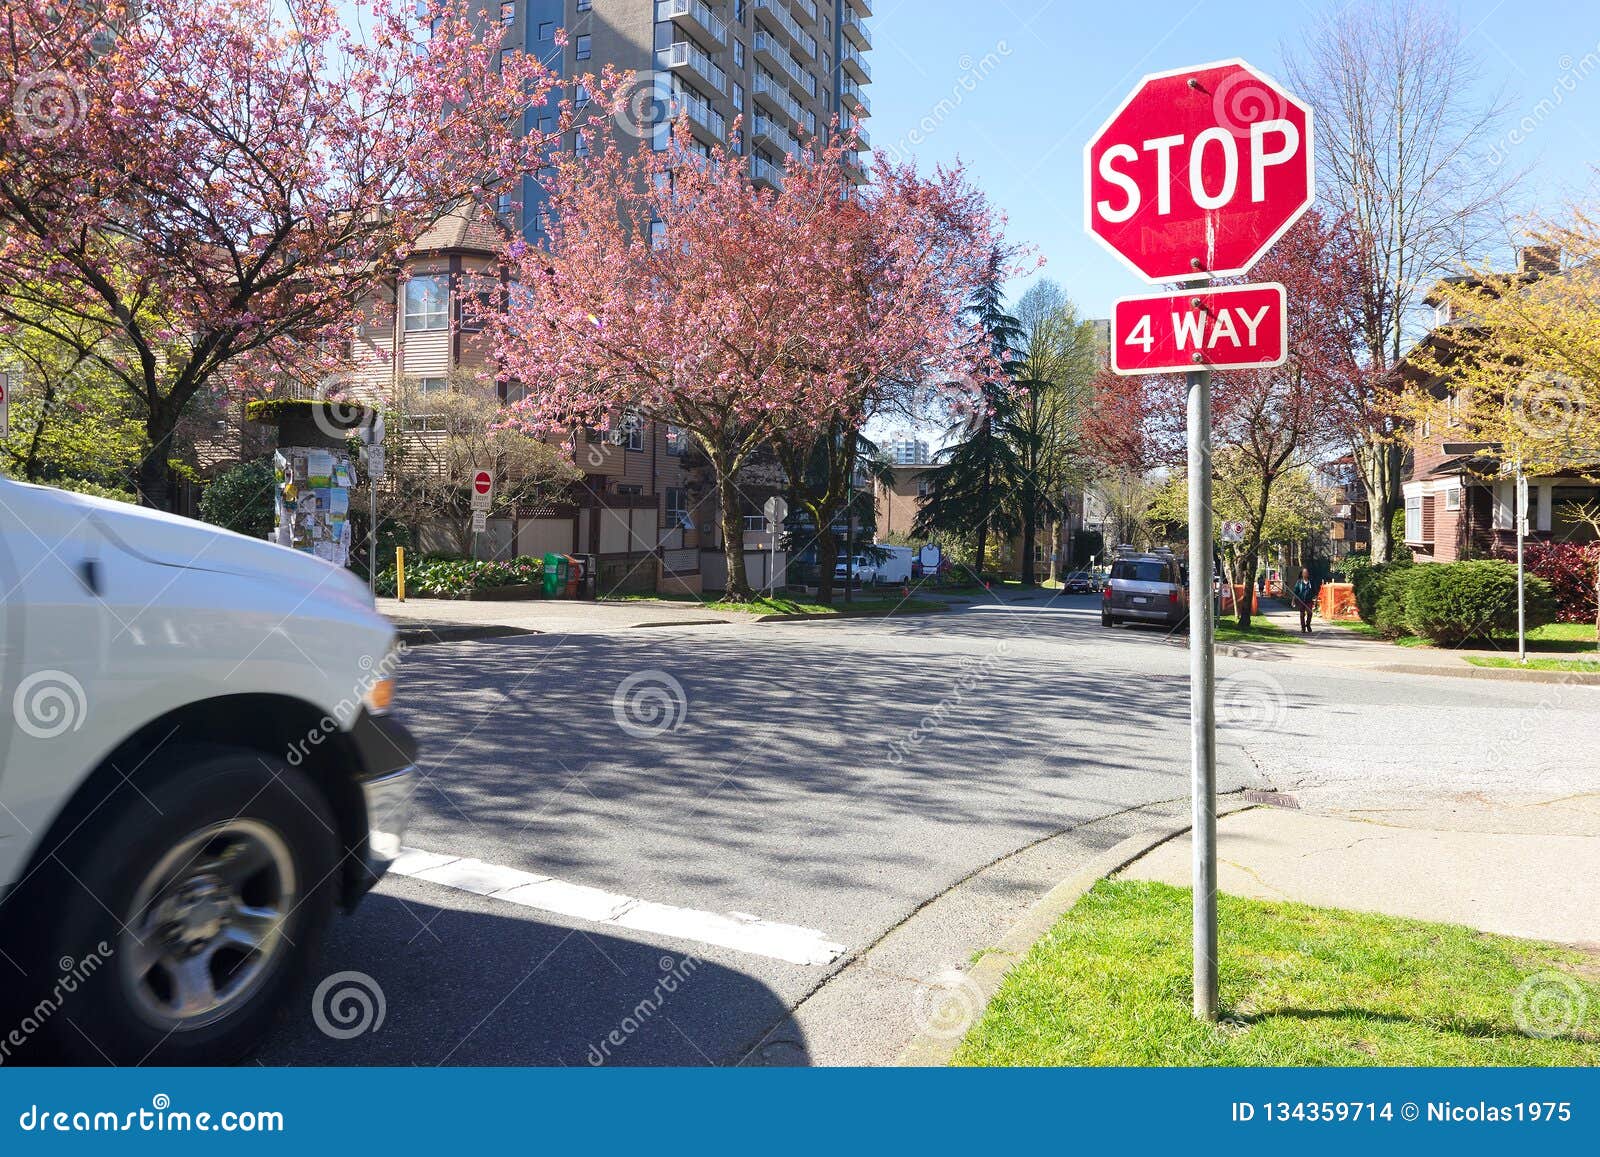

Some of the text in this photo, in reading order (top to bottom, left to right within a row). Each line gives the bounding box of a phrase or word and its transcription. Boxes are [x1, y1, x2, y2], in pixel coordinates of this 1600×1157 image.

[1097, 118, 1299, 224] STOP
[1125, 305, 1270, 352] 4 WAY
